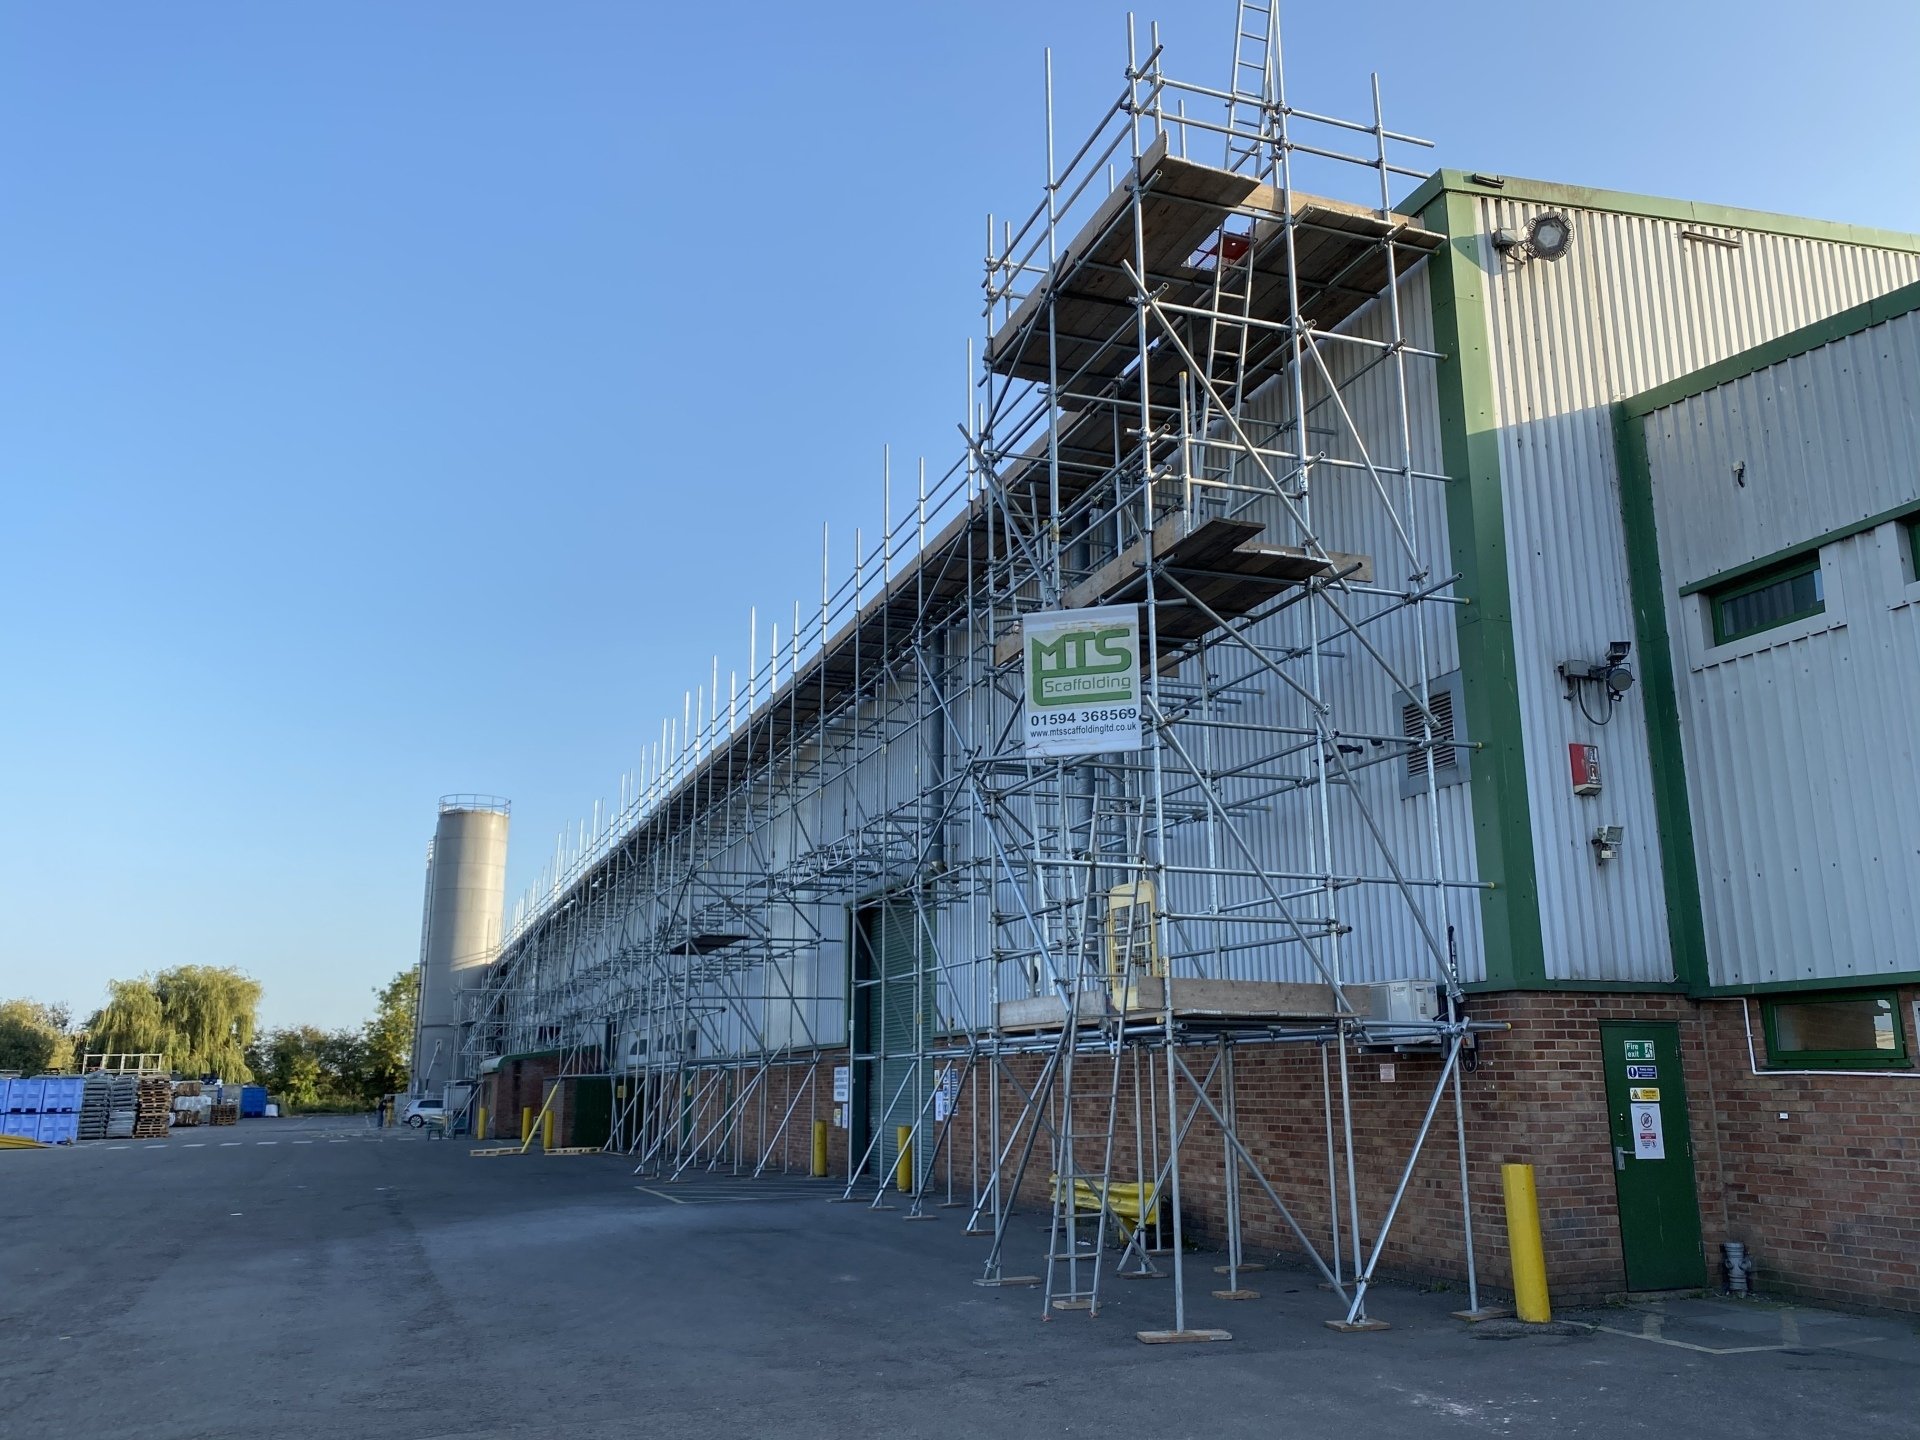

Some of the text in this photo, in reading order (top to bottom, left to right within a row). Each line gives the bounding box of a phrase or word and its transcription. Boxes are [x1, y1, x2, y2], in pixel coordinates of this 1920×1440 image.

[1032, 628, 1132, 674] MTS
[1044, 676, 1131, 693] Scaffolding
[1031, 708, 1137, 726] 01594 368569
[1030, 722, 1137, 738] www.mtsscaffoldingltd.co.uk
[1627, 1050, 1640, 1058] exit
